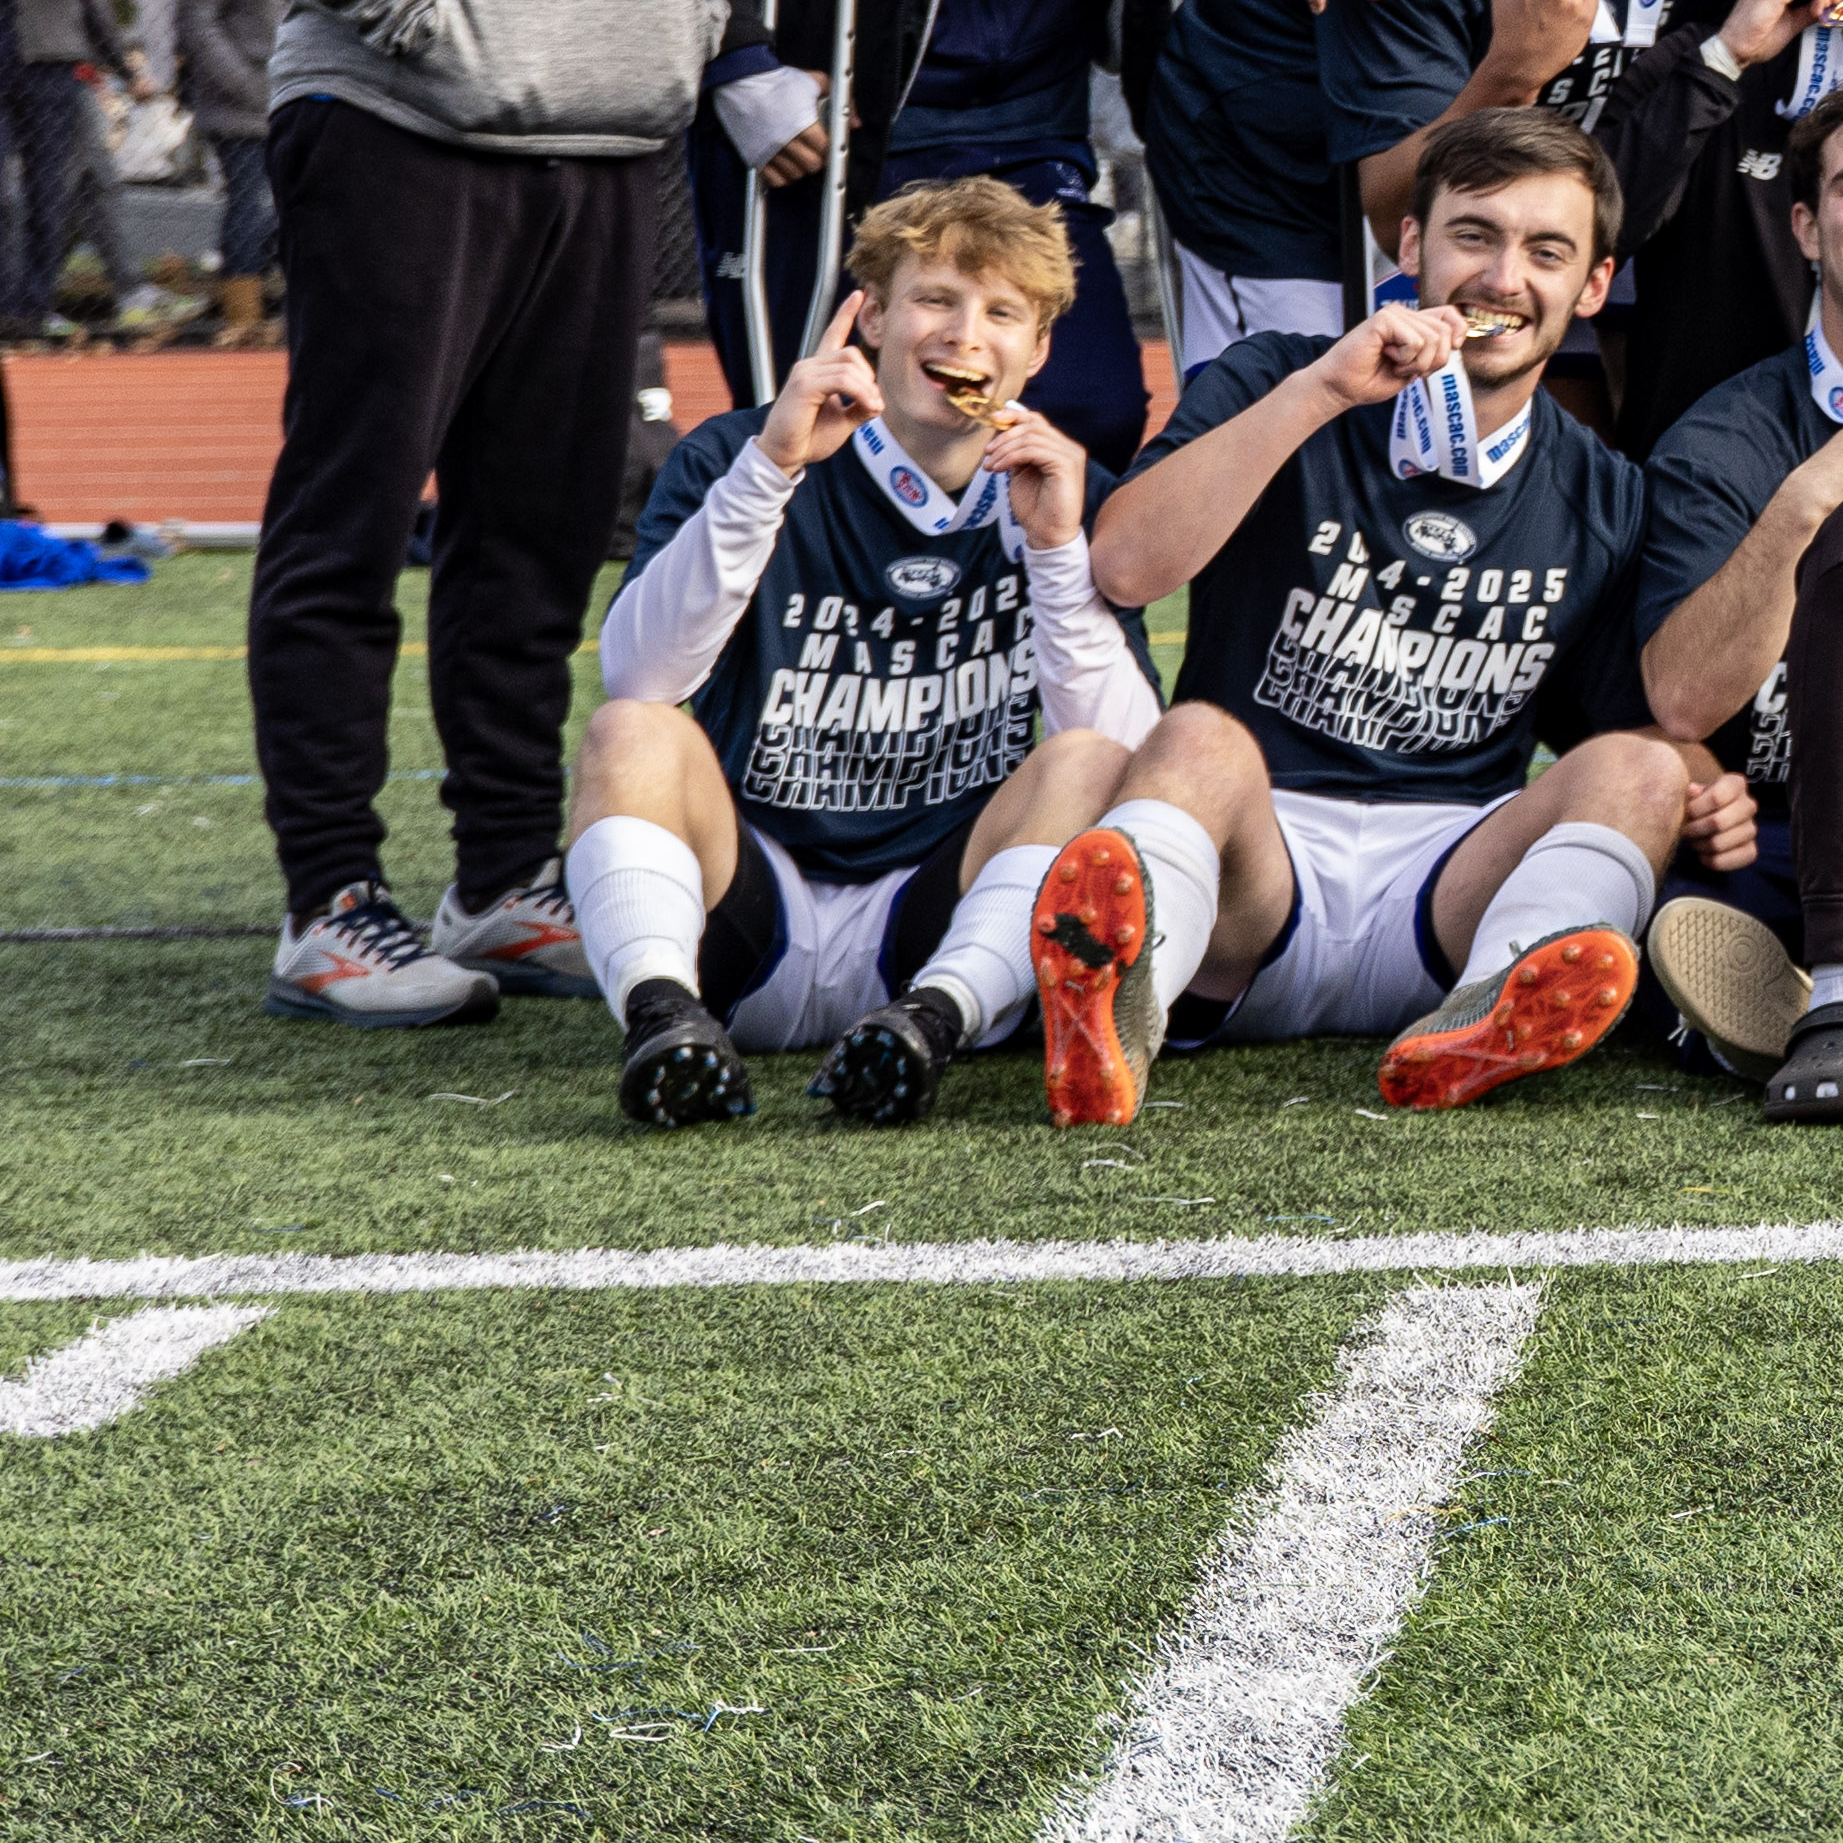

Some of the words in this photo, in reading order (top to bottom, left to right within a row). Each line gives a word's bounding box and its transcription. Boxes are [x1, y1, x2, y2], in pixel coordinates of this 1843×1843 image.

[1442, 374, 1469, 477] mascac.com
[764, 641, 1039, 734] CHAMPIONS
[1281, 588, 1556, 695] CHAMPIONS
